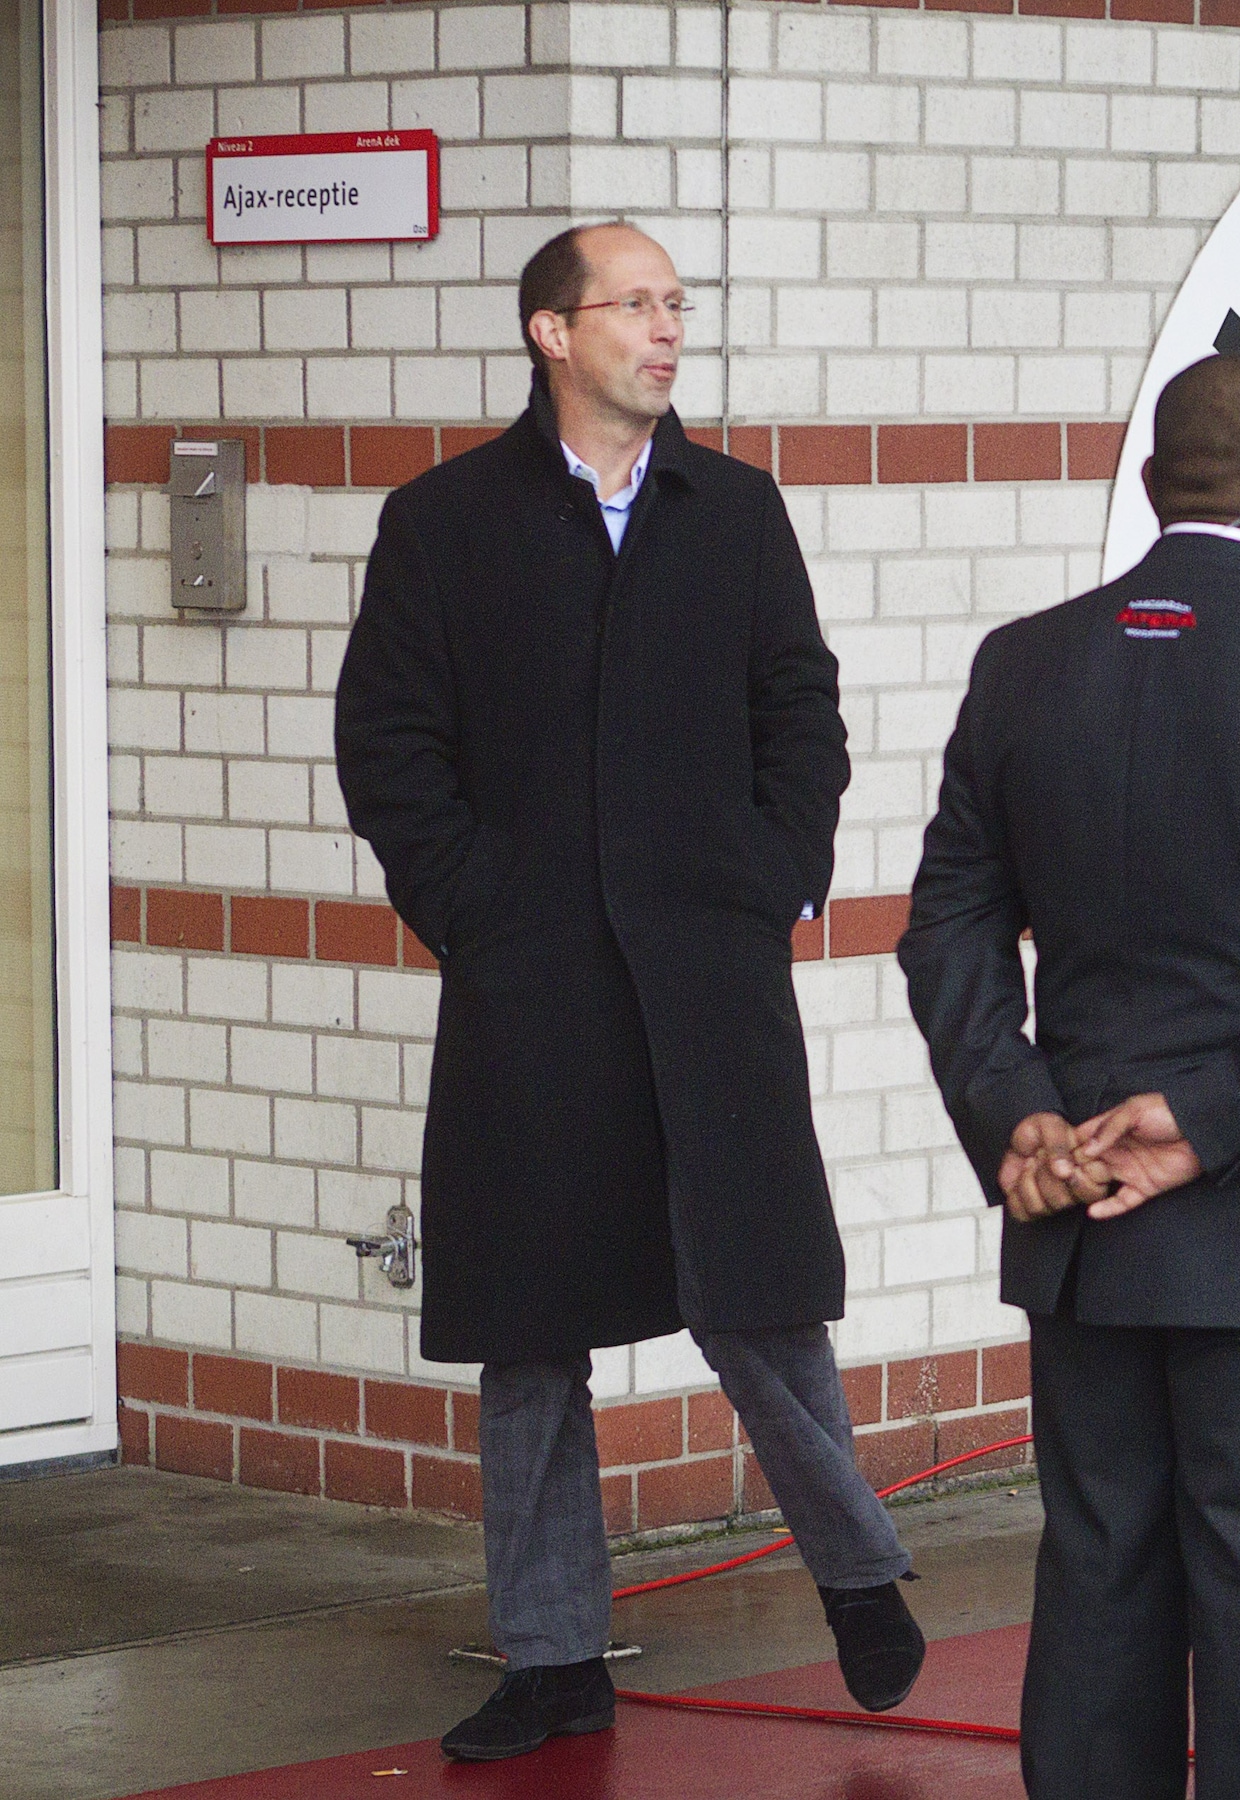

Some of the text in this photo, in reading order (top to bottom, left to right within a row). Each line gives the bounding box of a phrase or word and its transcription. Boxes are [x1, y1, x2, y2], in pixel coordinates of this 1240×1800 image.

[217, 140, 254, 152] Niveau 2
[356, 135, 400, 147] ArenA dek
[223, 181, 359, 217] Ajax-receptie
